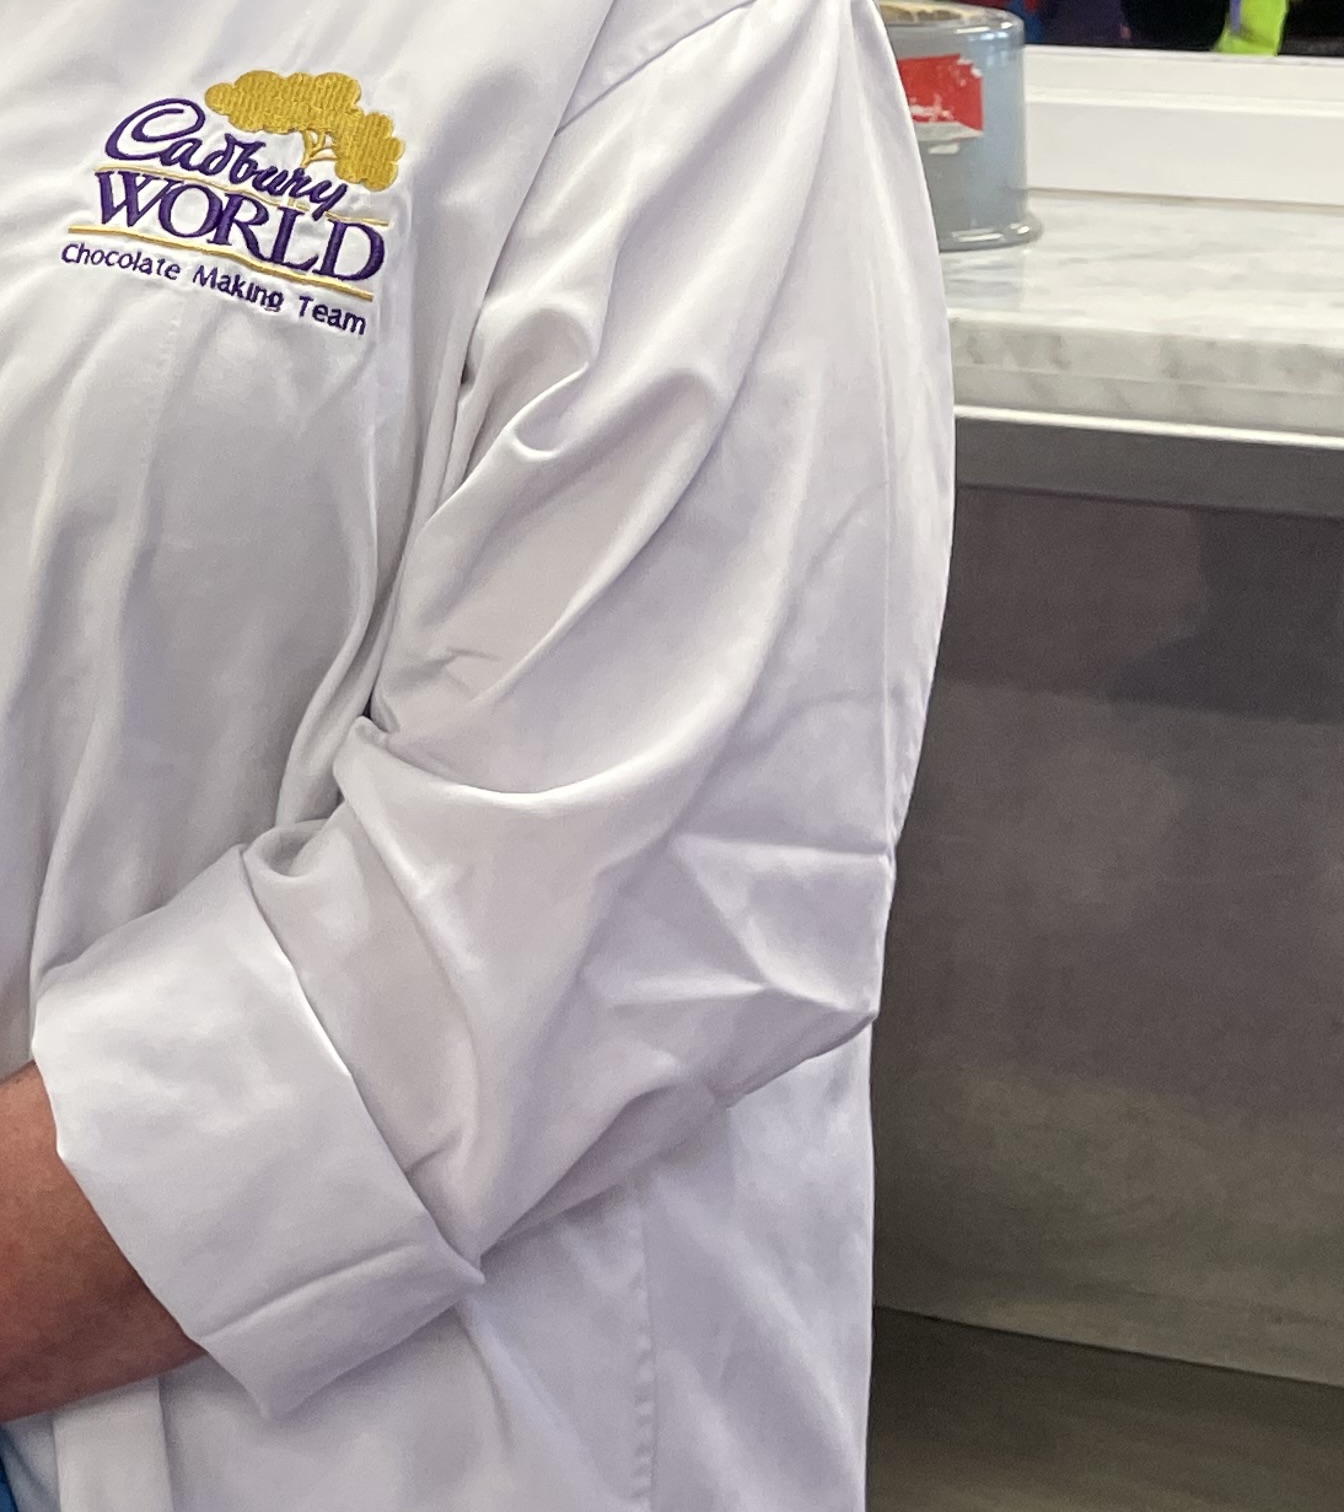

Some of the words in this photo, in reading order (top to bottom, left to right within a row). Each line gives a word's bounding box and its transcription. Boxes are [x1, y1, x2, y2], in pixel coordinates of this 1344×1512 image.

[104, 97, 349, 221] Cadbury
[94, 170, 386, 282] WORLD
[61, 242, 181, 280] Chocolate
[192, 264, 285, 312] Making
[298, 295, 367, 336] Team
